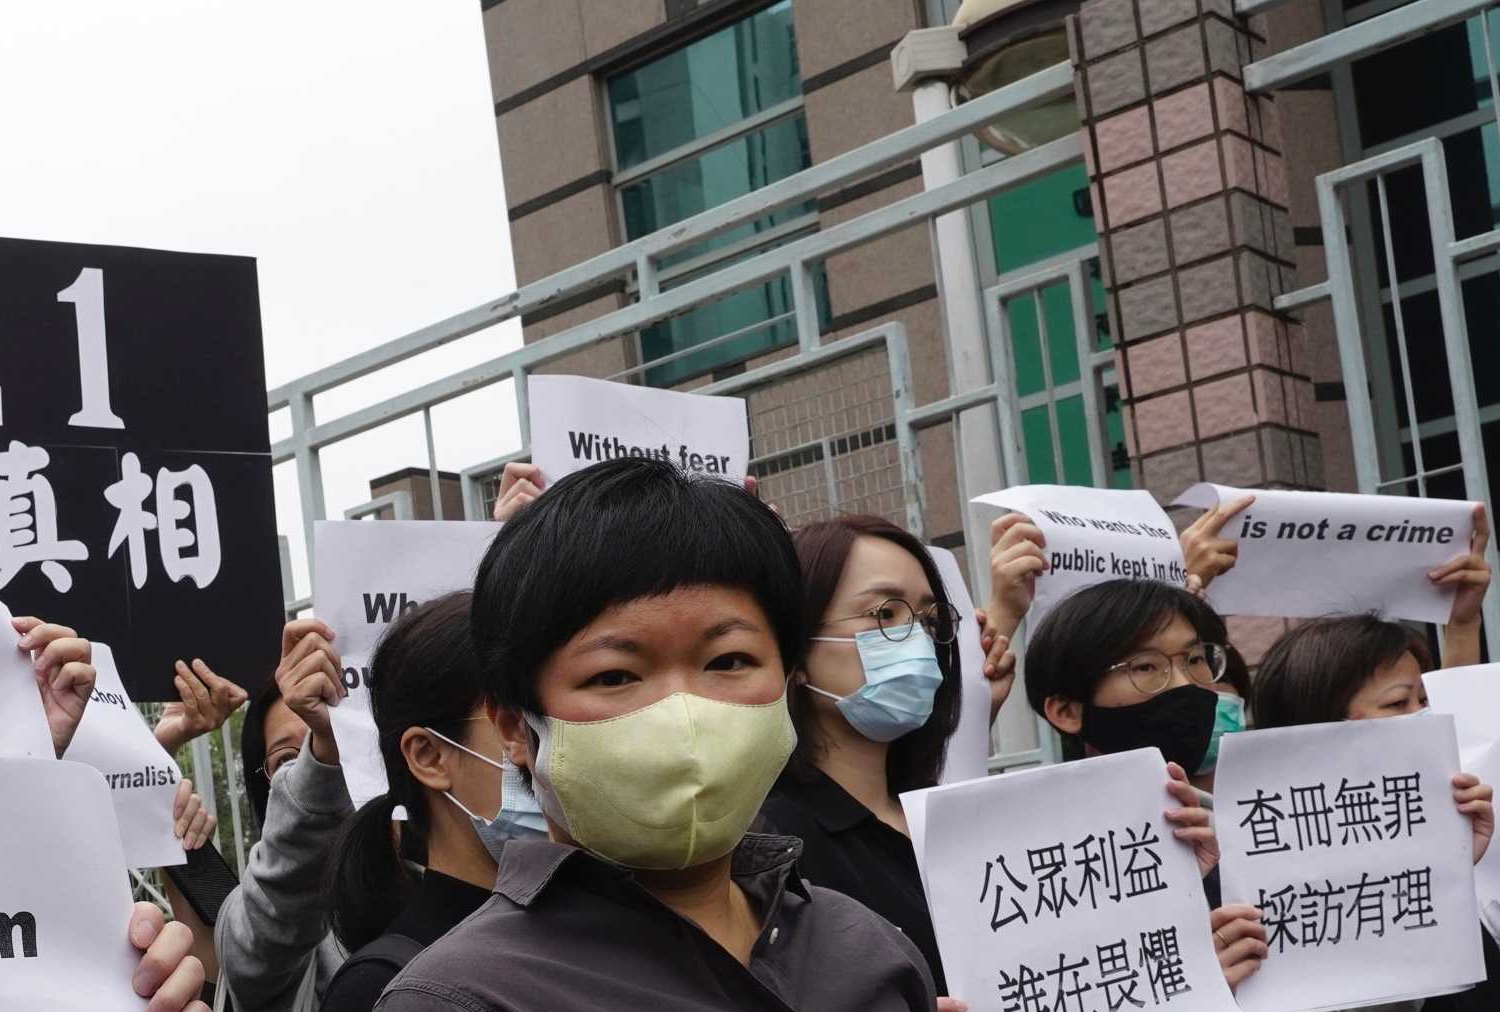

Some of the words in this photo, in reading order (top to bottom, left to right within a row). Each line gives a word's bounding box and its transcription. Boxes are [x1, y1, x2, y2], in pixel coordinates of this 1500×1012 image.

[679, 445, 730, 474] fear
[1039, 509, 1086, 528] Who
[1086, 518, 1142, 536] wants
[1140, 523, 1172, 540] the
[1240, 515, 1267, 539] is
[1276, 518, 1329, 540] not
[1336, 523, 1357, 541] a
[1366, 519, 1454, 545] crime
[1050, 548, 1106, 576] public
[1110, 552, 1148, 581] kept
[1152, 557, 1167, 583] in
[1237, 771, 1426, 856] 查冊無罪
[979, 822, 1168, 932] 公眾利益
[1254, 866, 1438, 953] 採訪有理
